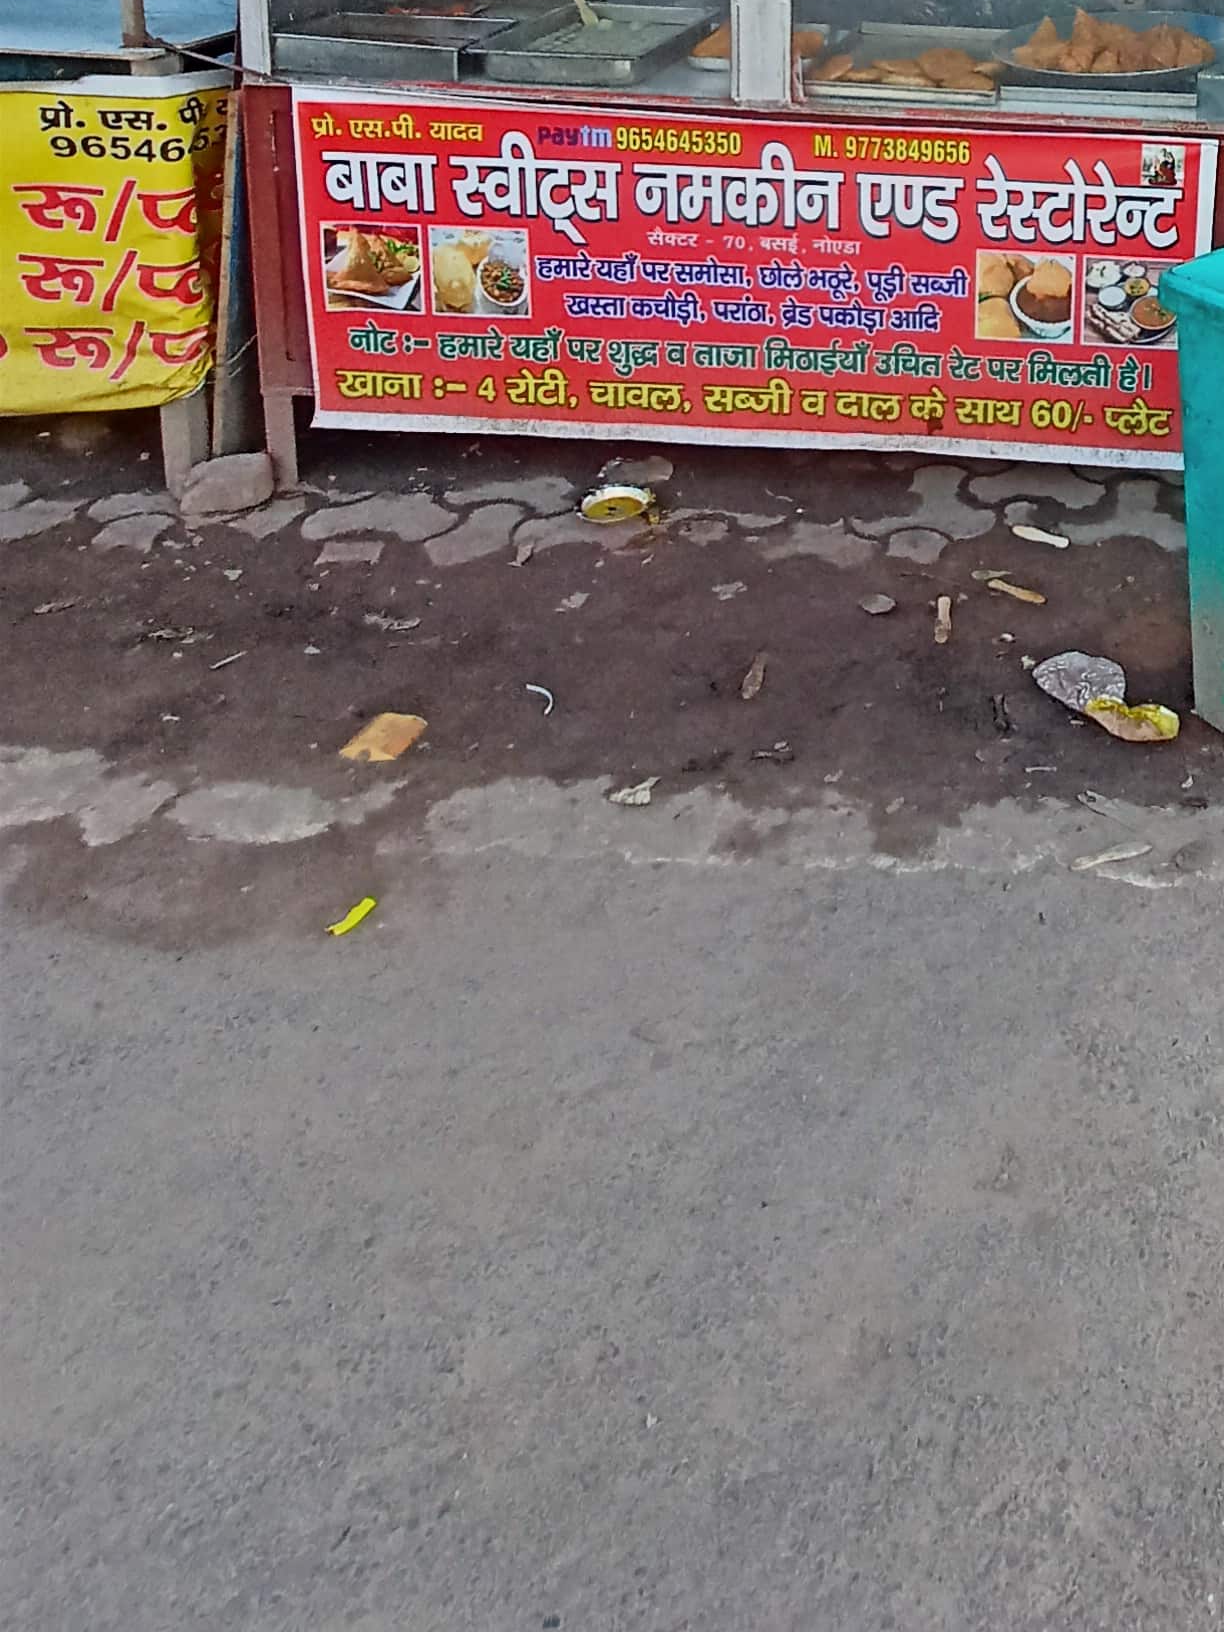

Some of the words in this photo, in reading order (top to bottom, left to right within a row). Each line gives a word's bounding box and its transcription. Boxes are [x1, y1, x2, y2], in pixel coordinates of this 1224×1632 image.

[39, 101, 85, 131] प्रो.
[97, 110, 167, 131] एस.
[311, 112, 342, 139] प्रो.
[429, 120, 484, 142] यादव
[616, 126, 743, 156] 9654645350
[813, 134, 838, 158] M.
[845, 136, 971, 165] 9773849656
[321, 151, 438, 212] बाबा
[449, 130, 622, 246] स्वीट्स
[633, 140, 845, 232] नमकीन
[856, 172, 964, 244] एण्ड
[975, 154, 1183, 249] रेस्टोरेन्ट
[812, 236, 861, 256] नोएडा
[535, 252, 590, 281] हमारे
[593, 253, 639, 283] यहाँ
[641, 258, 670, 282] पर
[675, 257, 752, 288] समोसा,
[758, 259, 803, 290] छोले
[910, 266, 968, 298] सब्जी
[565, 294, 626, 318] खस्ता
[781, 297, 814, 330] ब्रेड
[890, 302, 941, 334] आदि
[348, 321, 398, 355] नोट
[437, 326, 503, 362] हमारे
[509, 328, 565, 364] यहाँ
[567, 337, 602, 366] पर
[607, 338, 660, 377] शुद्ध
[666, 340, 687, 367] व
[874, 343, 942, 378] उचित
[948, 345, 981, 381] रेट
[987, 357, 1022, 383] पर
[1028, 350, 1112, 389] मिलती
[335, 368, 423, 399] खाना
[478, 378, 496, 403] 4
[506, 368, 578, 409] रोटी,
[589, 379, 692, 413] चावल,
[703, 377, 793, 416] सब्जी
[800, 391, 827, 417] व
[835, 389, 901, 420] दाल
[909, 387, 948, 421] के
[955, 397, 1022, 426] साथ
[1030, 399, 1095, 433] 60/-
